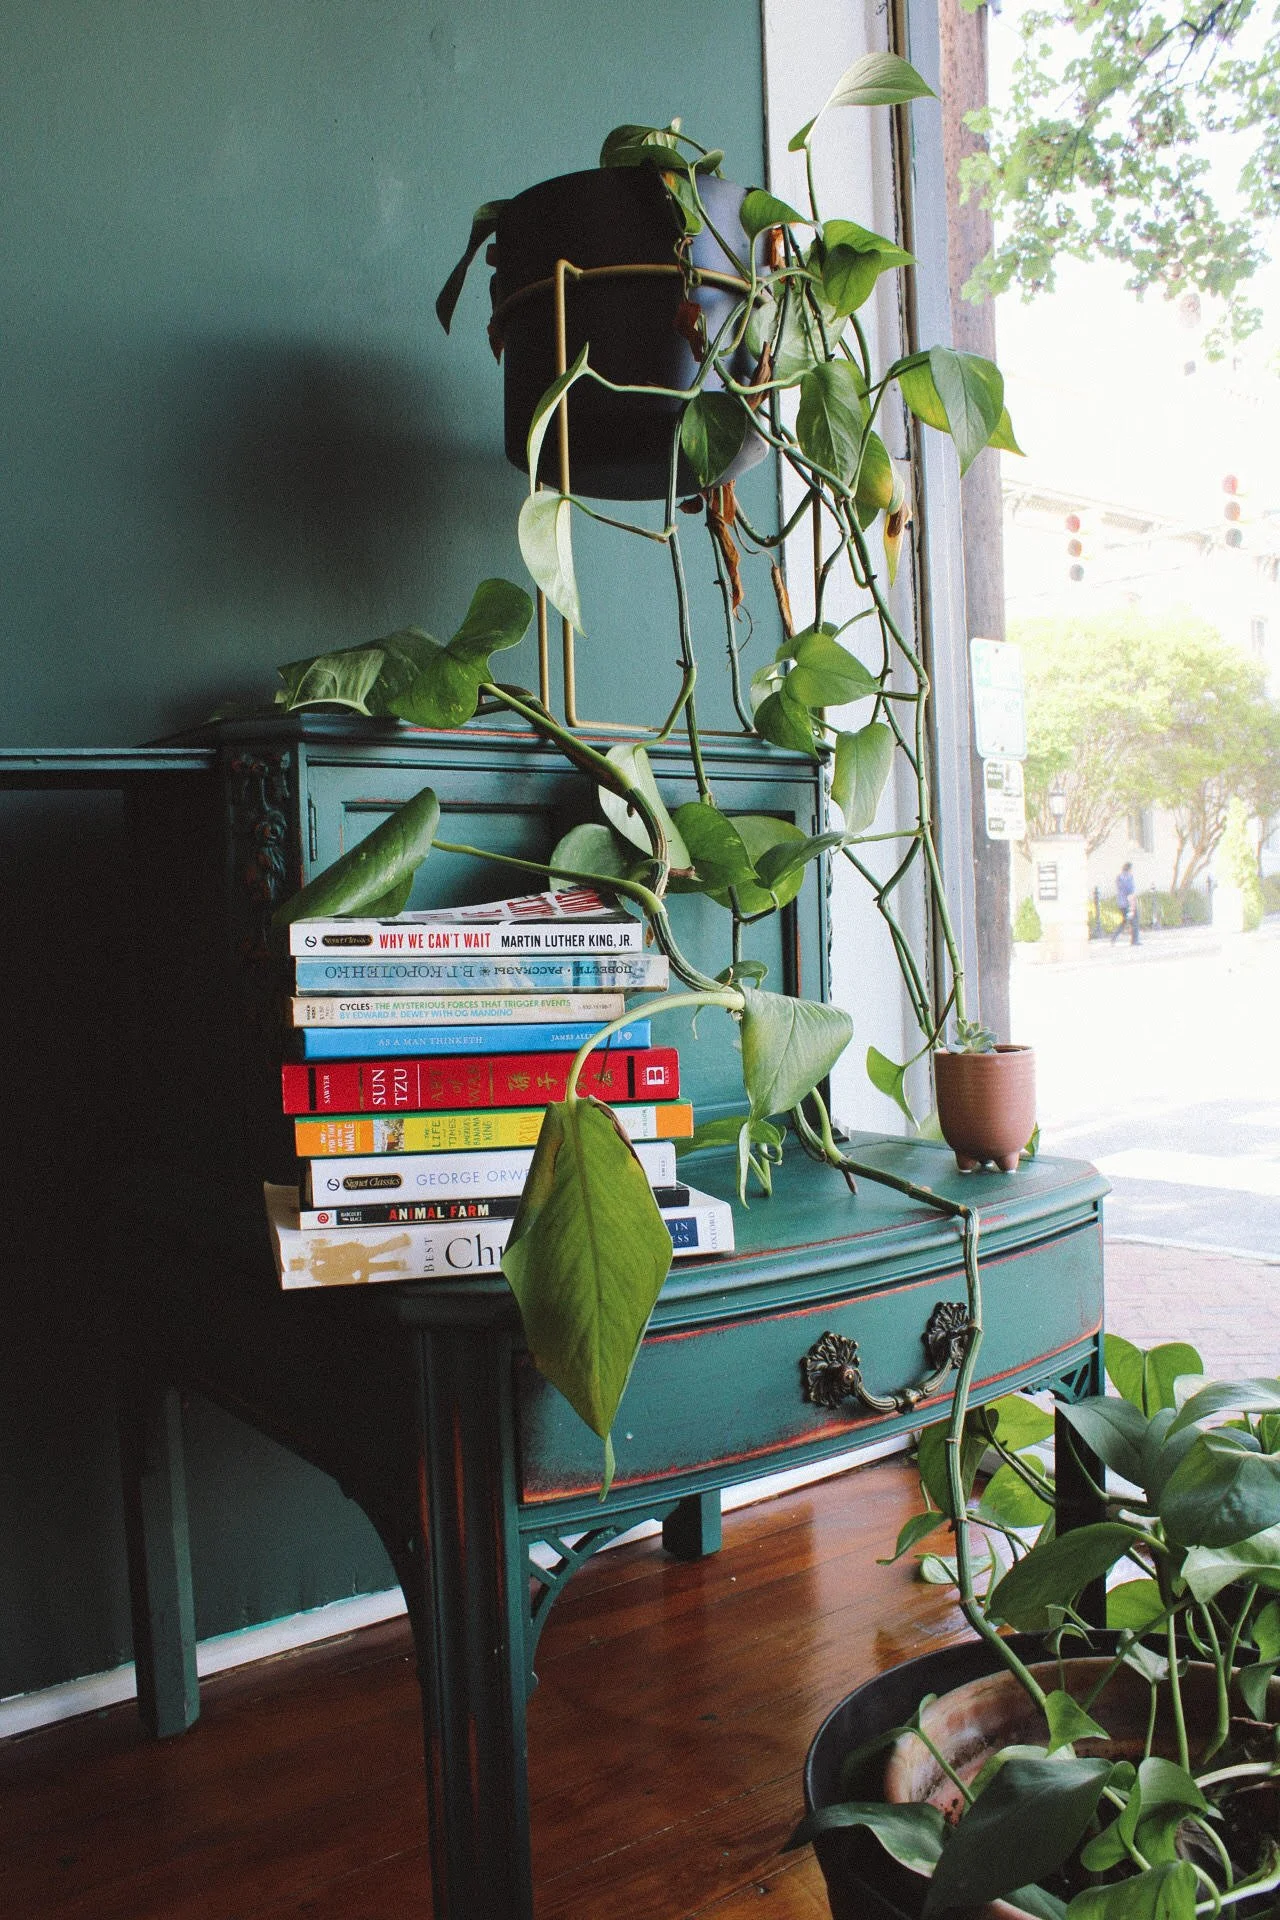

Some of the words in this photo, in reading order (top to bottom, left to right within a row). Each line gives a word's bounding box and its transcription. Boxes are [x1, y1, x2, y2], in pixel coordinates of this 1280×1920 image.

[380, 934, 404, 948] WHY
[408, 934, 424, 948] WE
[428, 933, 459, 948] CAN'T
[463, 933, 491, 948] WAIT
[501, 934, 541, 948] MARTIN
[545, 934, 585, 948] LUTHER
[588, 934, 616, 948] KING,
[619, 934, 633, 947] JR.
[494, 966, 563, 975] РАССКАЗЫ
[575, 965, 632, 974] ПОВЕСТИ
[339, 1011, 350, 1019] BY
[353, 1011, 389, 1019] EDWARD
[400, 1010, 429, 1018] DEWEY
[431, 1010, 453, 1018] WITH
[470, 1009, 512, 1017] MANDINO
[375, 1002, 391, 1010] THE
[392, 1001, 445, 1009] MYSTERIOUS
[447, 1001, 479, 1009] FORCES
[480, 1000, 502, 1008] THAT
[504, 1000, 540, 1008] TRIGGER
[541, 999, 571, 1007] EVENTS
[403, 1038, 426, 1046] MAN
[430, 1036, 483, 1046] THINKETH
[550, 1034, 574, 1042] JAMES
[323, 1075, 331, 1104] SAWYER
[371, 1069, 386, 1105] SUN
[394, 1068, 408, 1106] TZU
[430, 1066, 444, 1103] ART
[448, 1077, 464, 1095] of
[467, 1064, 481, 1104] WAR
[344, 1121, 355, 1152] WHALE
[431, 1120, 440, 1148] LIFE
[448, 1118, 457, 1147] TIMES
[472, 1117, 480, 1146] BANANA
[482, 1120, 493, 1141] KING
[519, 1115, 539, 1143] RICH
[344, 1179, 368, 1190] Signet
[369, 1177, 400, 1187] Classics
[416, 1171, 479, 1186] GEORGE
[390, 1206, 445, 1221] ANIMAL
[450, 1204, 489, 1218] FARM
[675, 1222, 688, 1232] IN
[708, 1211, 719, 1249] OXFORD
[423, 1236, 435, 1273] BEST
